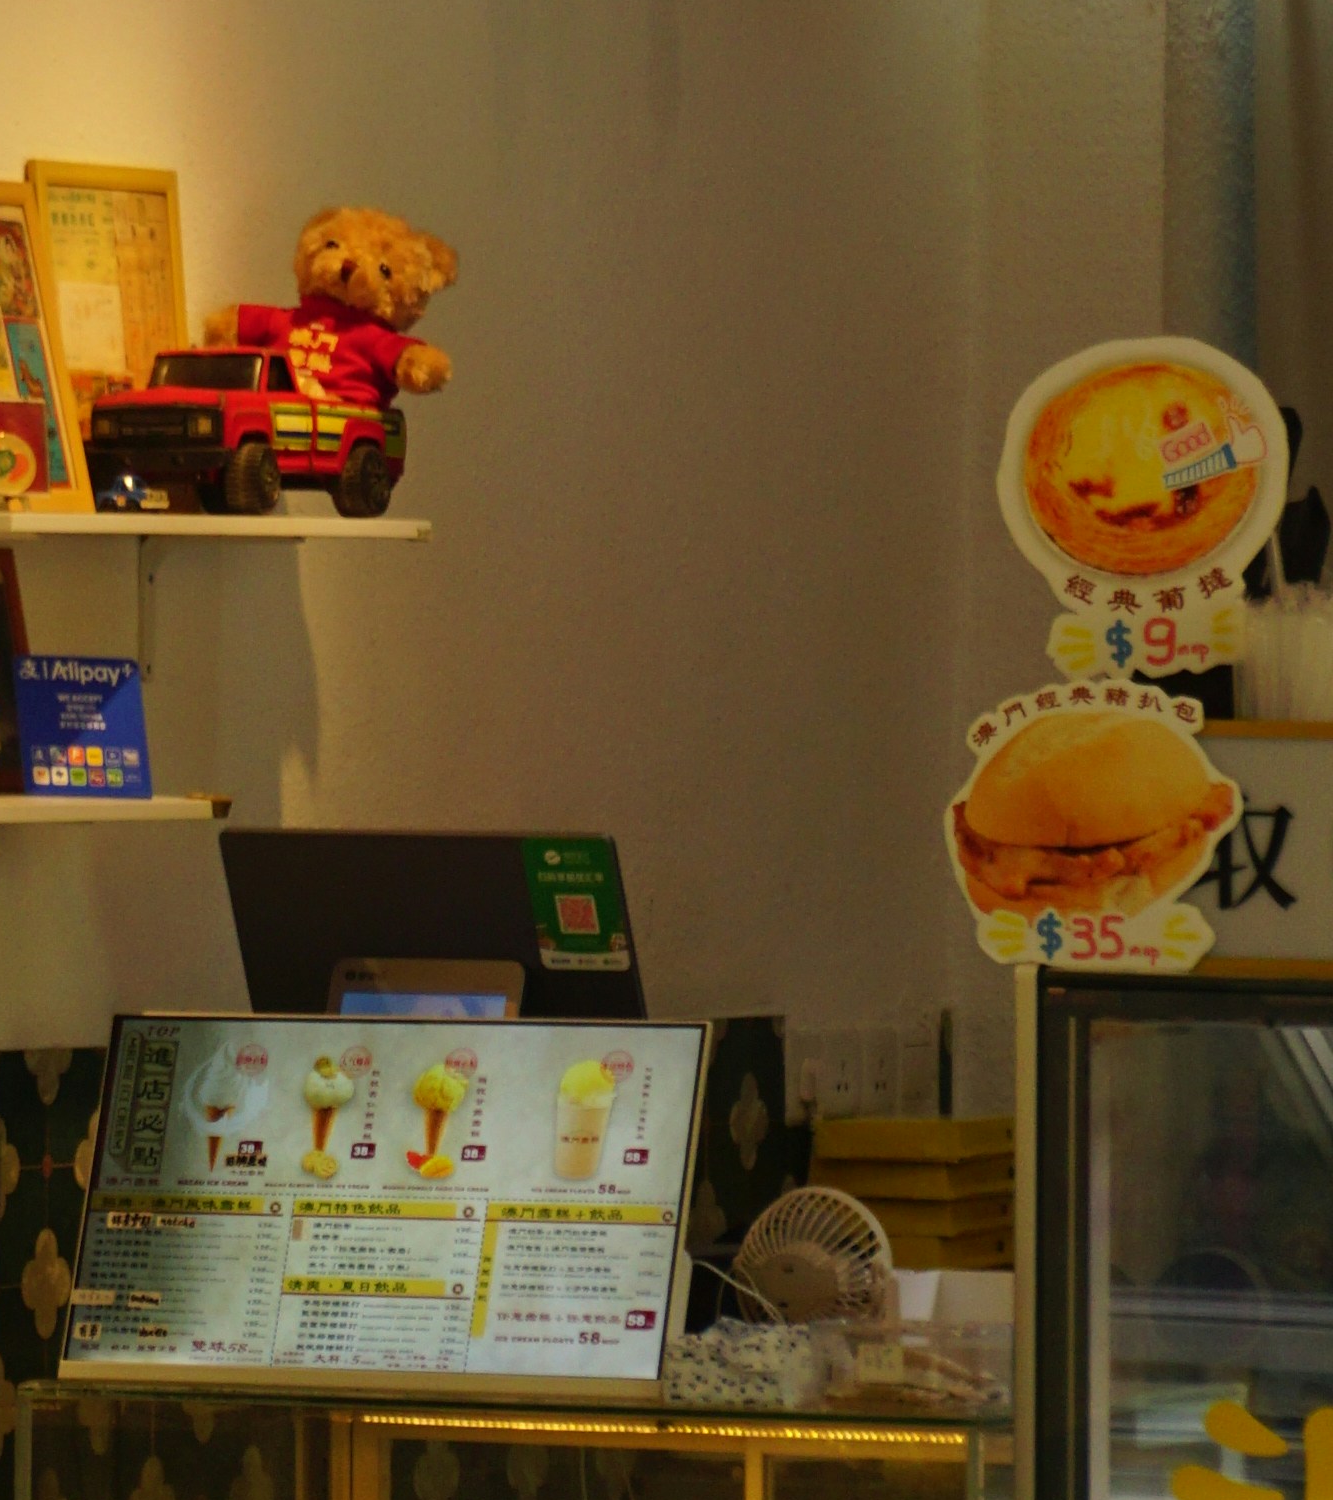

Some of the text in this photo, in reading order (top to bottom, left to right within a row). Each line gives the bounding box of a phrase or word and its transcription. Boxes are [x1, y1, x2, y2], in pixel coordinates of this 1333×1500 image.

[1162, 422, 1211, 463] Good
[1064, 567, 1233, 613] 經典葡撻
[972, 686, 1199, 748] 澳門經典豬扒包
[597, 1183, 616, 1195] 58
[578, 1331, 601, 1346] 58
